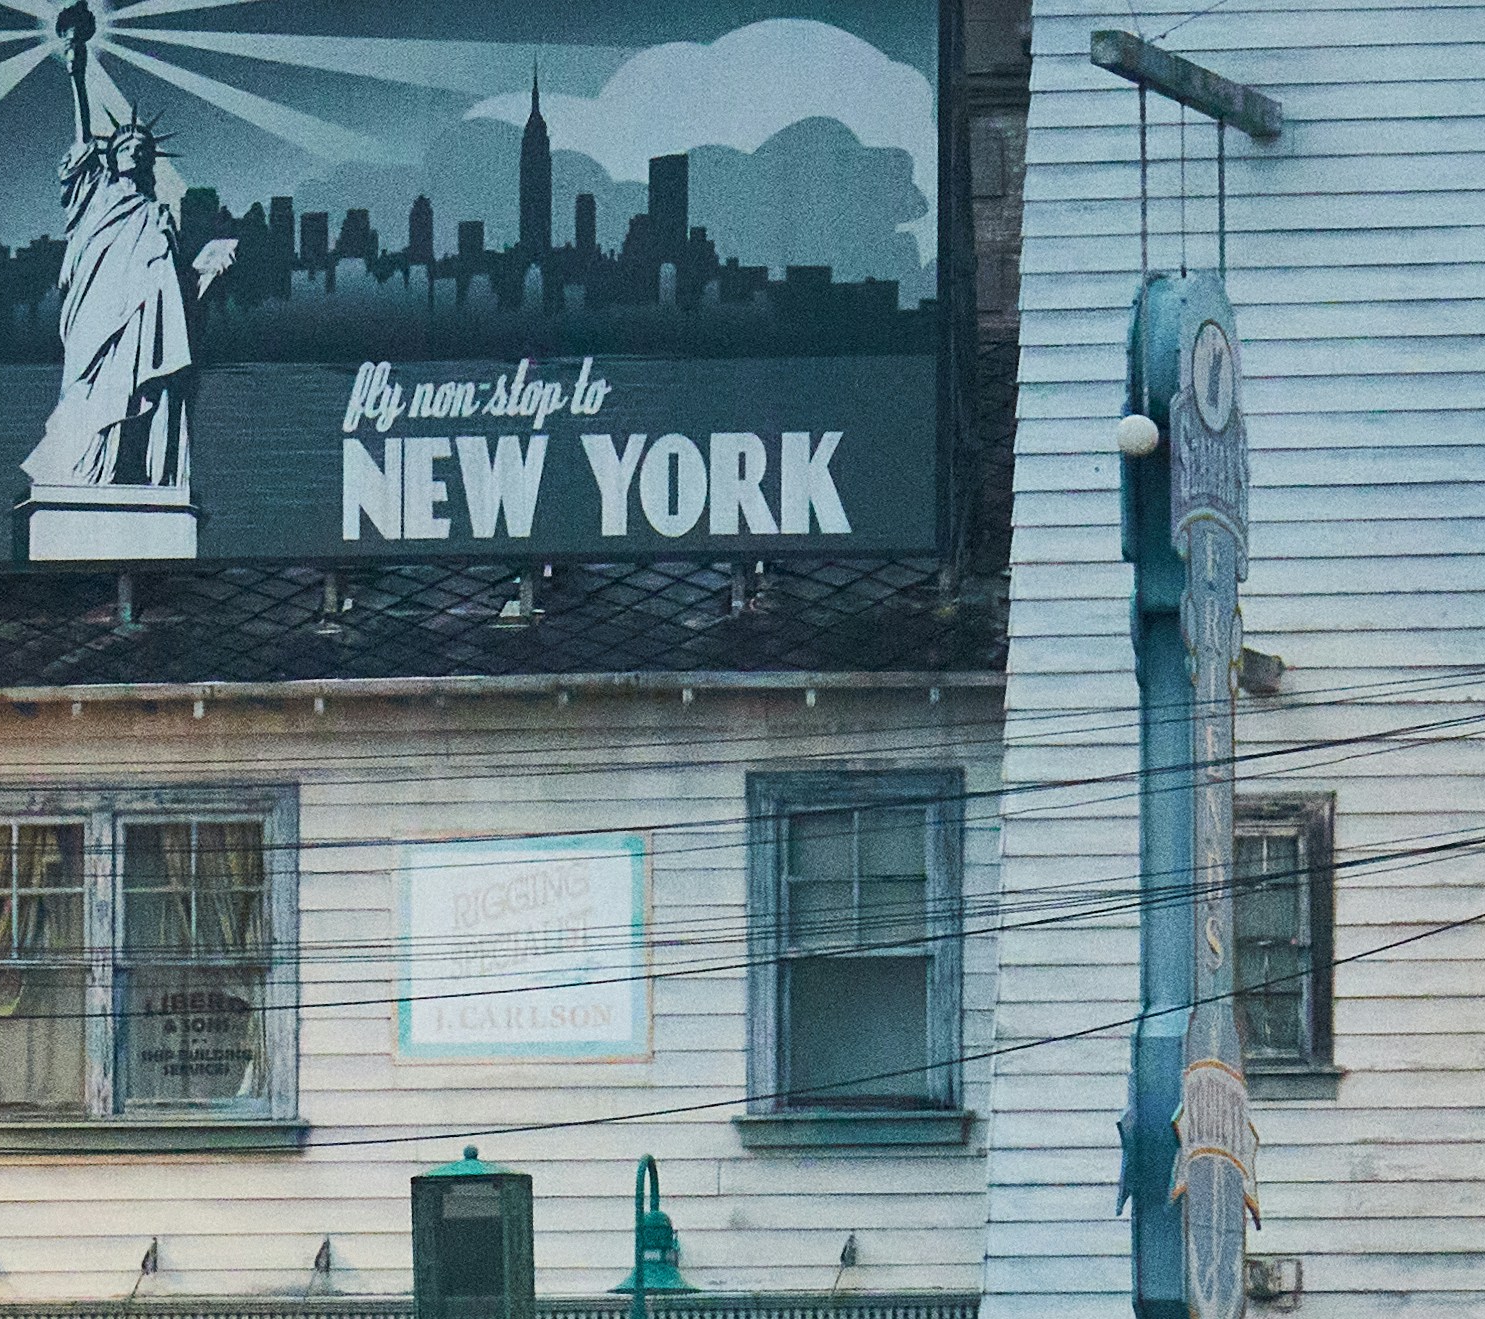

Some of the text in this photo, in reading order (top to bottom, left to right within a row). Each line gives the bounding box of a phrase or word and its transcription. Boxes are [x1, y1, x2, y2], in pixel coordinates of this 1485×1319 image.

[343, 357, 612, 431] fly non-stop to
[343, 431, 852, 540] NEW YORK
[451, 866, 591, 930] RIGGING
[459, 1003, 612, 1030] CARLSON
